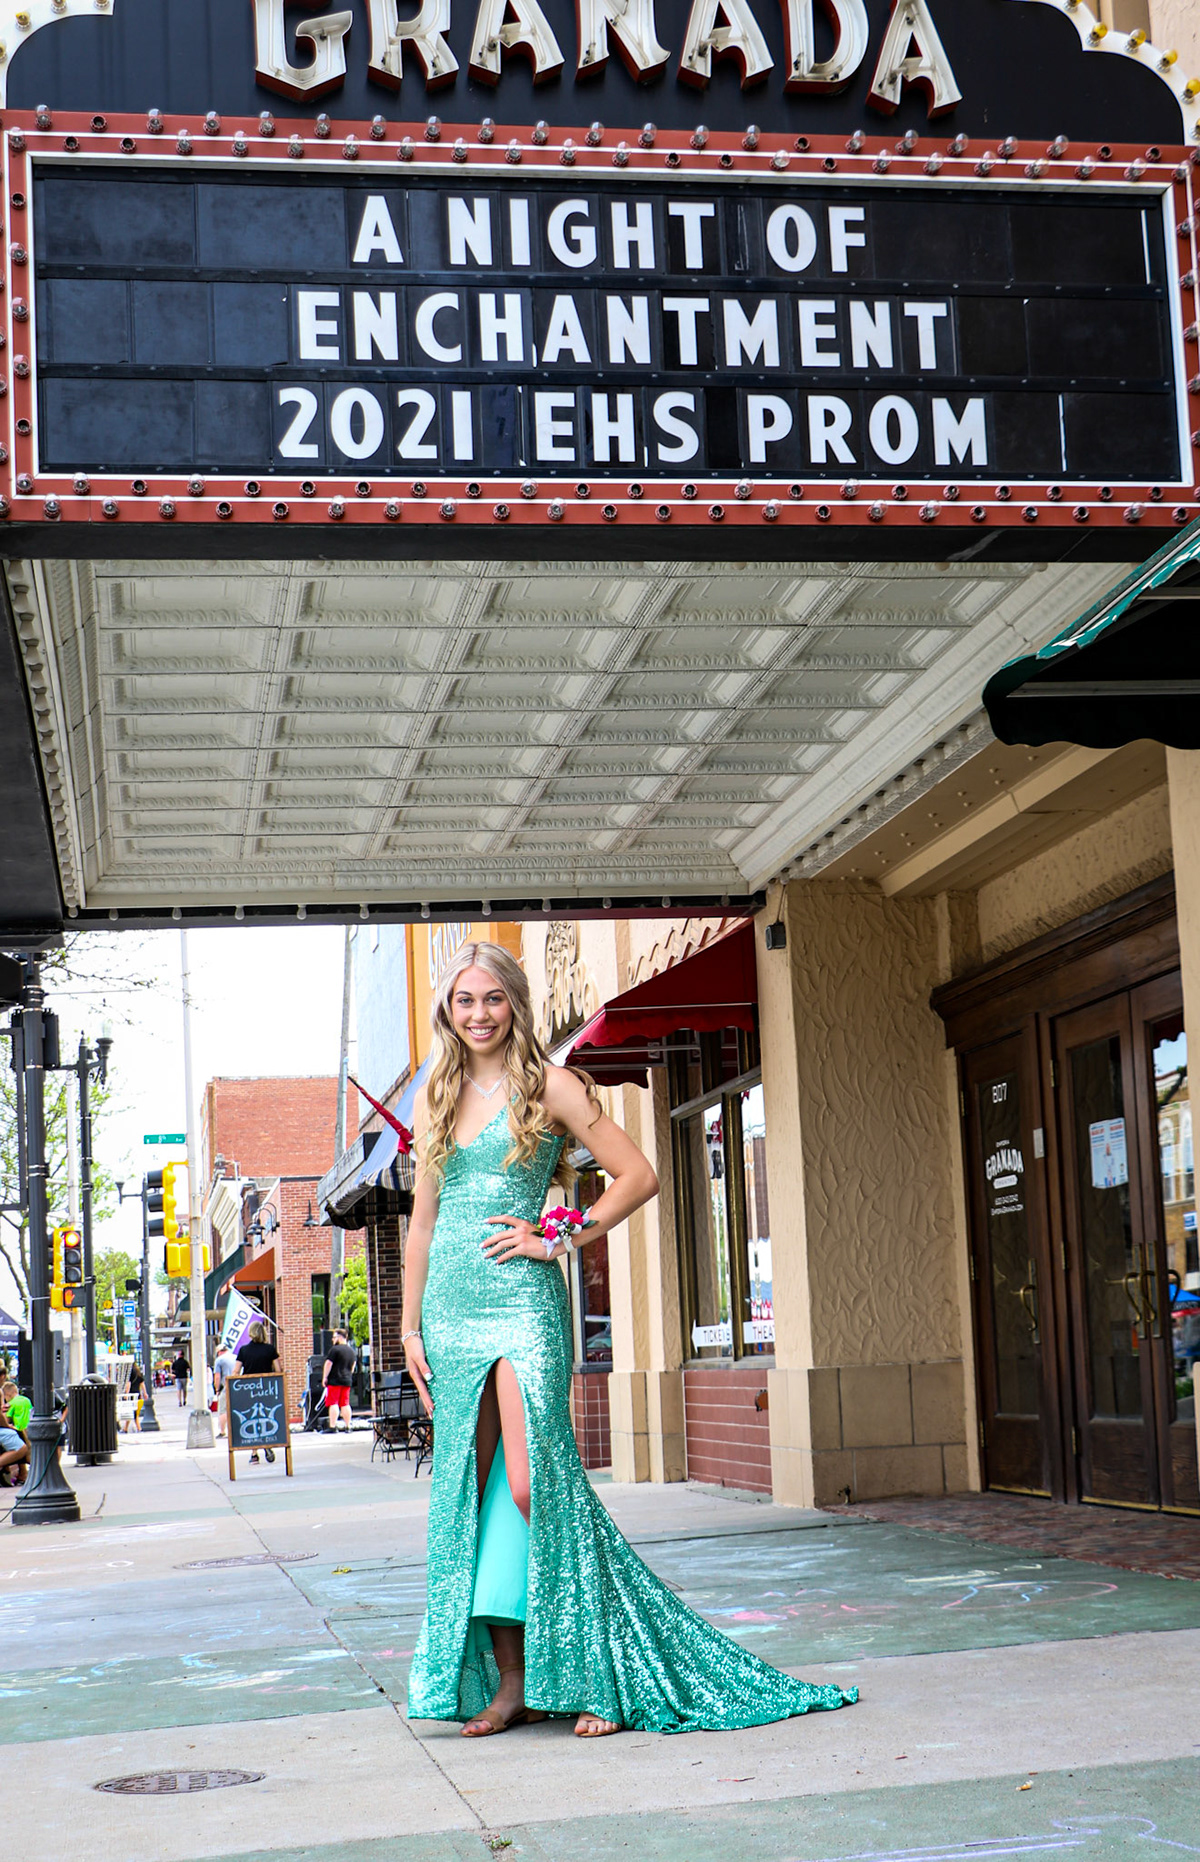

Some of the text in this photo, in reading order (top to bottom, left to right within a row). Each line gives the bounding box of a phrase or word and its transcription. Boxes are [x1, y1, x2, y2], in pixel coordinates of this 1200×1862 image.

[252, 0, 963, 116] GRANADA
[352, 195, 866, 273] A NIGHT OF
[298, 291, 948, 370] ENCHANTMENT
[278, 387, 988, 466] 2021 EHS PROM
[992, 1083, 1008, 1103] 807
[986, 1148, 1024, 1180] GRANADA
[232, 1377, 263, 1391] Good
